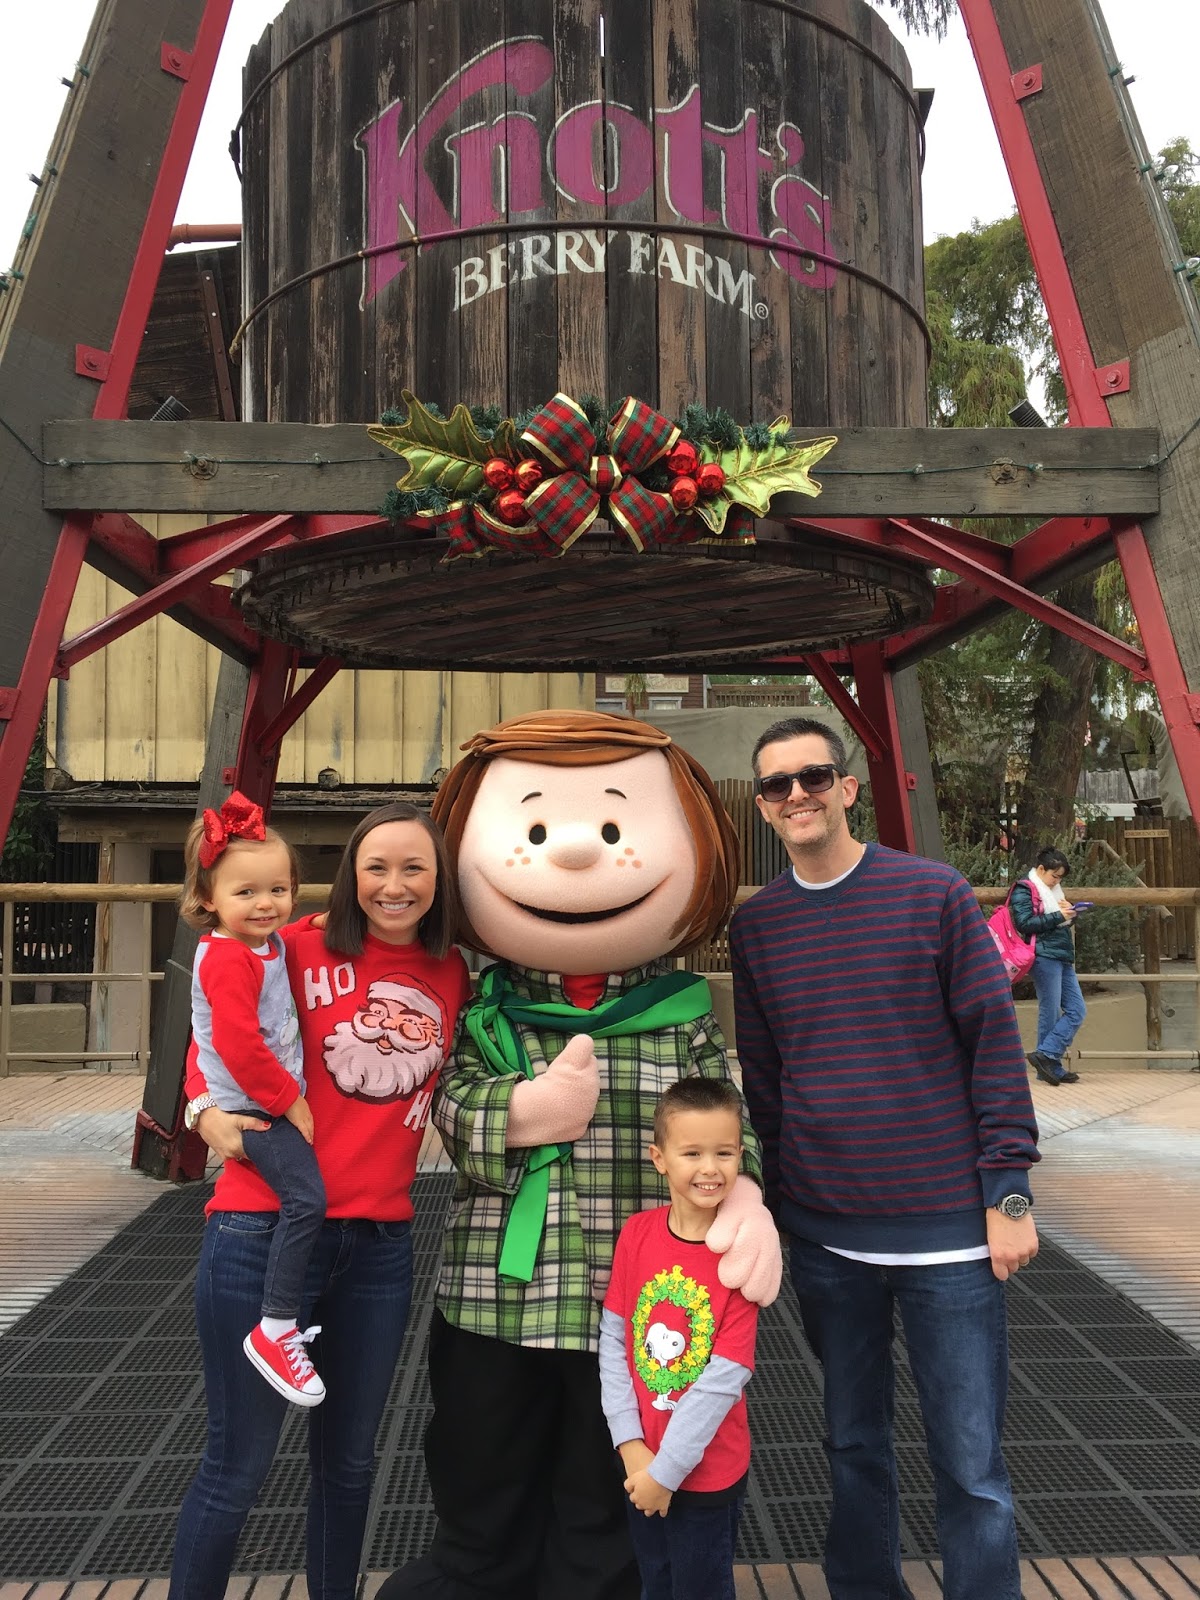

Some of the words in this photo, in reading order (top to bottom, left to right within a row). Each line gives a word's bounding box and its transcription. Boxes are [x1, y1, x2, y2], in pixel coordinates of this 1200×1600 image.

[353, 35, 837, 312] Knott's
[453, 229, 620, 312] BERRY
[303, 961, 356, 1011] HO
[403, 1090, 433, 1132] H
